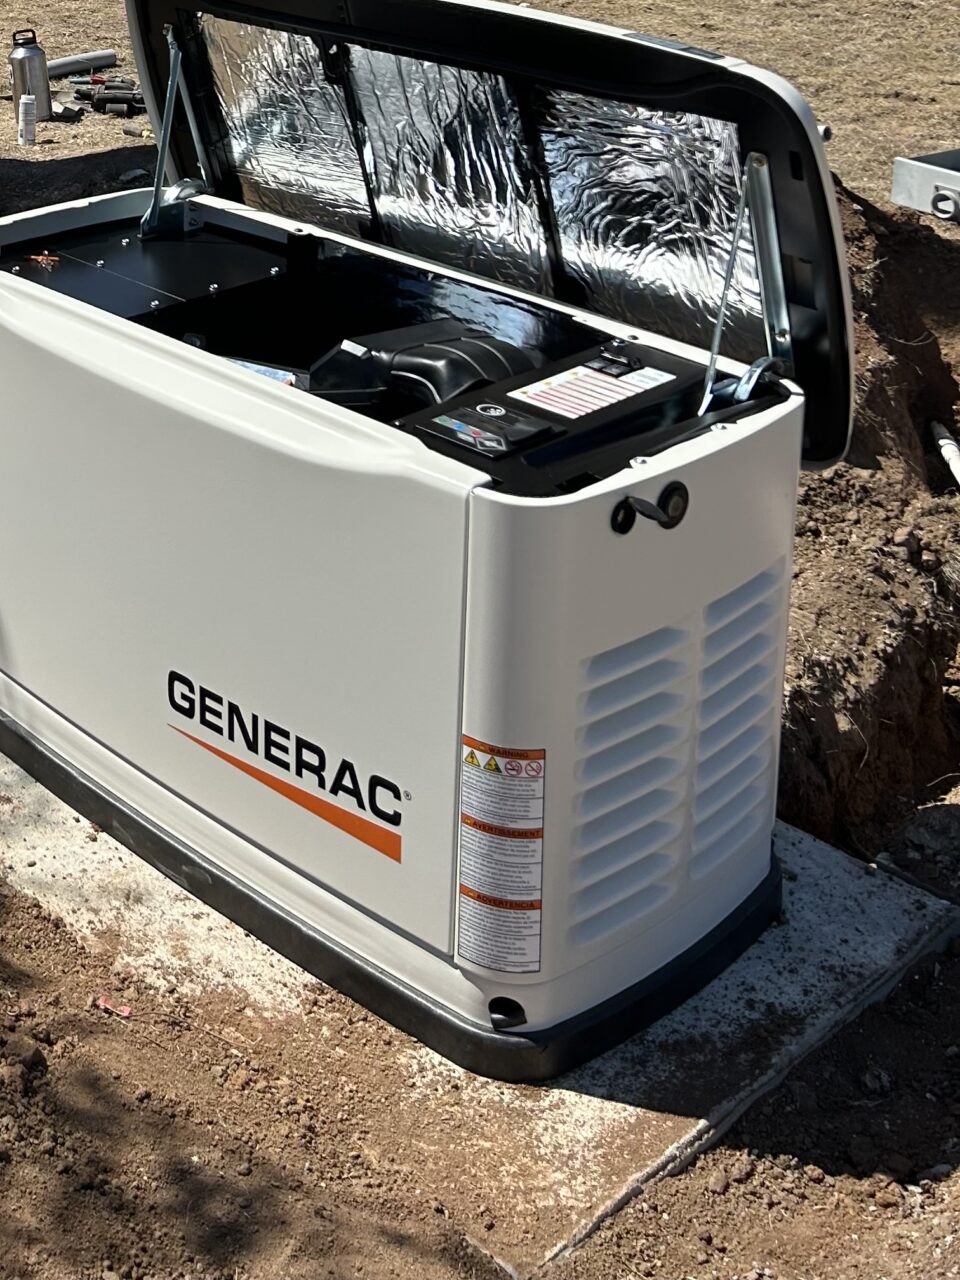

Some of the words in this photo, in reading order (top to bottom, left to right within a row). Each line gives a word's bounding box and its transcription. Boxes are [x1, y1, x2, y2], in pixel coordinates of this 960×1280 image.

[167, 669, 403, 827] GENERAC
[488, 746, 529, 758] WARNING
[472, 820, 540, 837] AVERTISSEMENT
[476, 893, 536, 907] ADVERTENCIA
